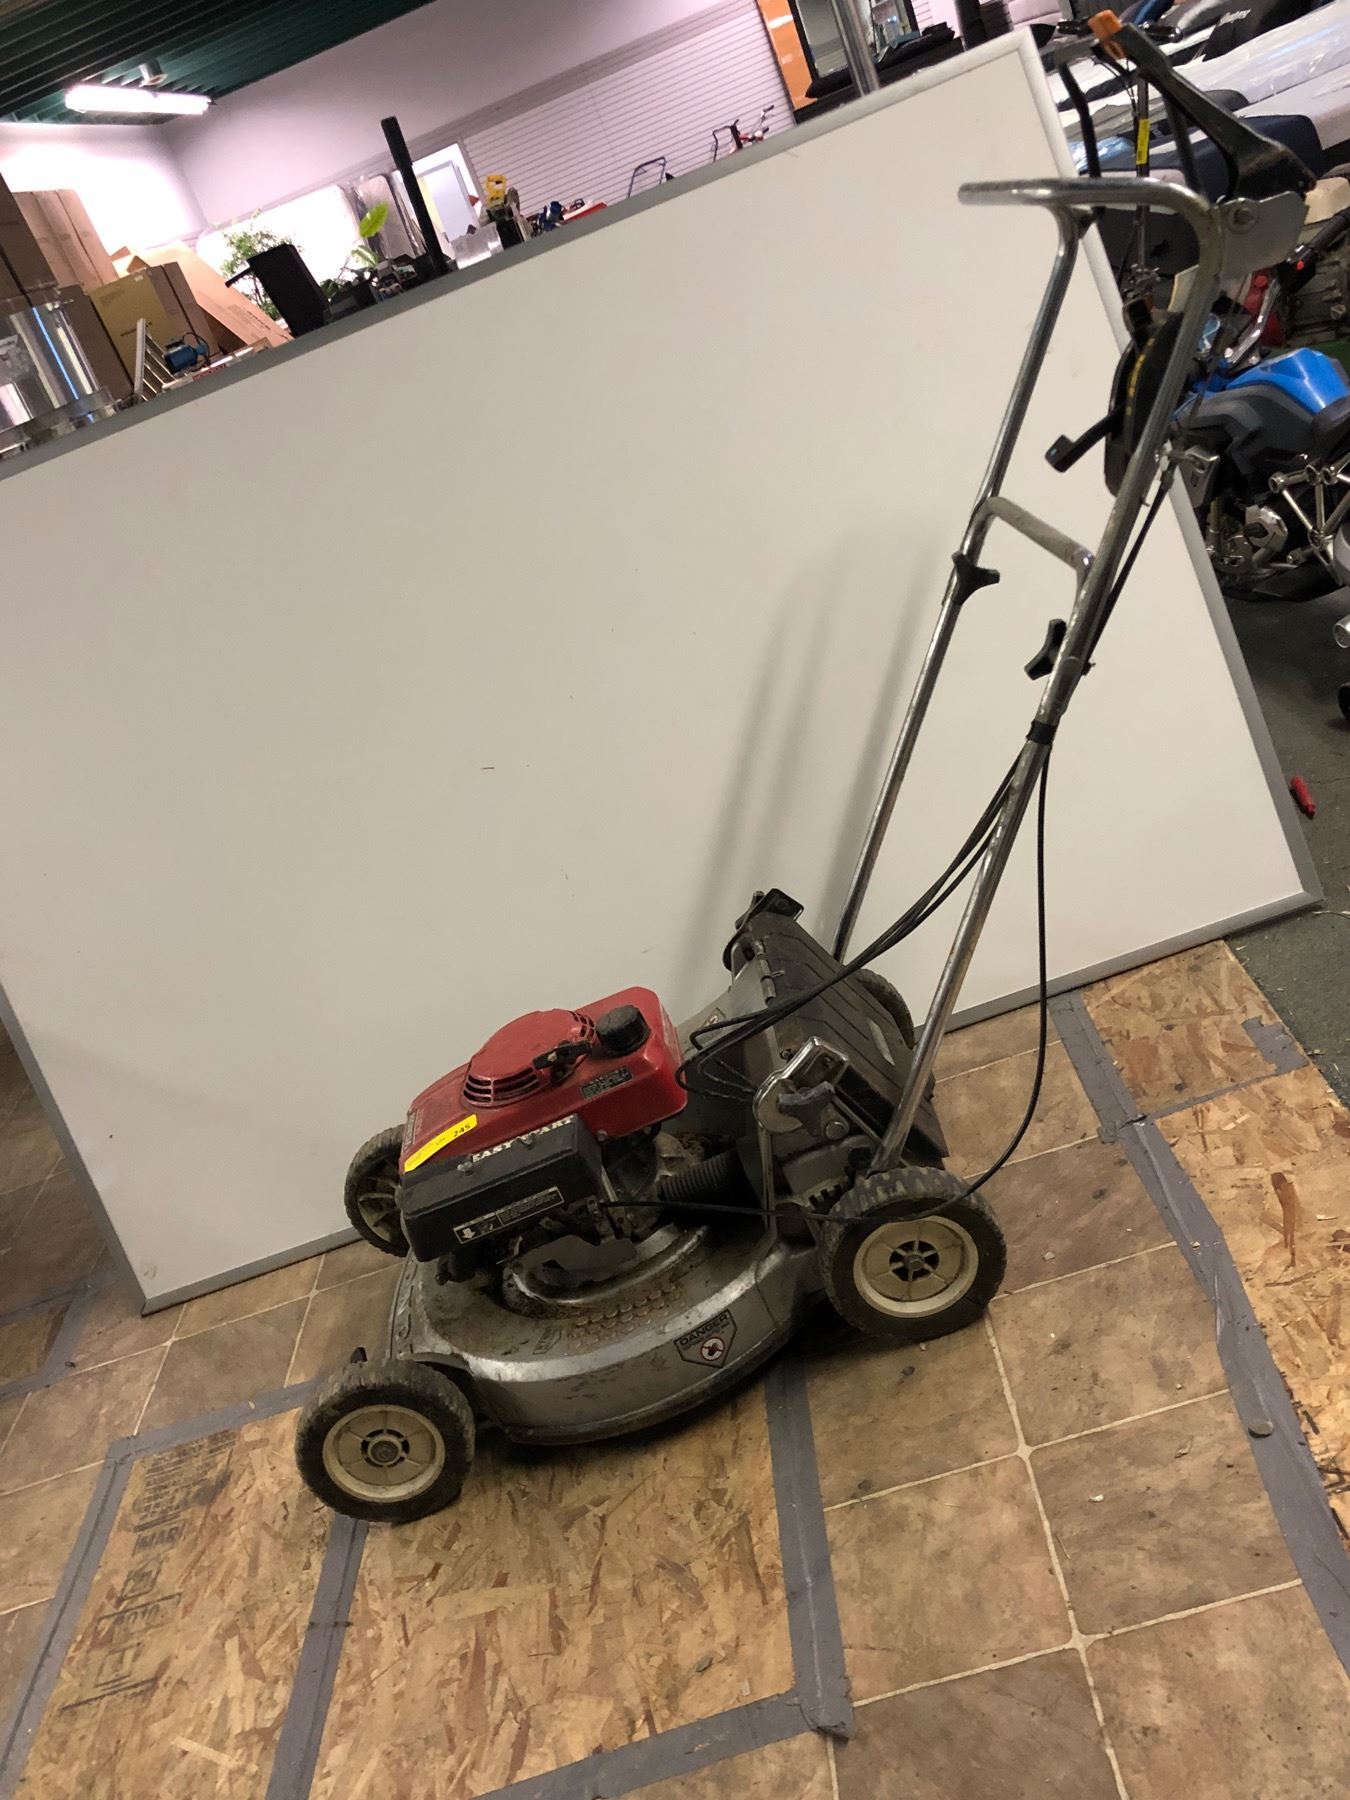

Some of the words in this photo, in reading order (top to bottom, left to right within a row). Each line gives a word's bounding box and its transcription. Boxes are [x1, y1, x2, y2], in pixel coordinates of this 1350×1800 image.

[453, 1123, 471, 1138] 245
[472, 1137, 517, 1163] EASY
[679, 1313, 727, 1347] DANGER
